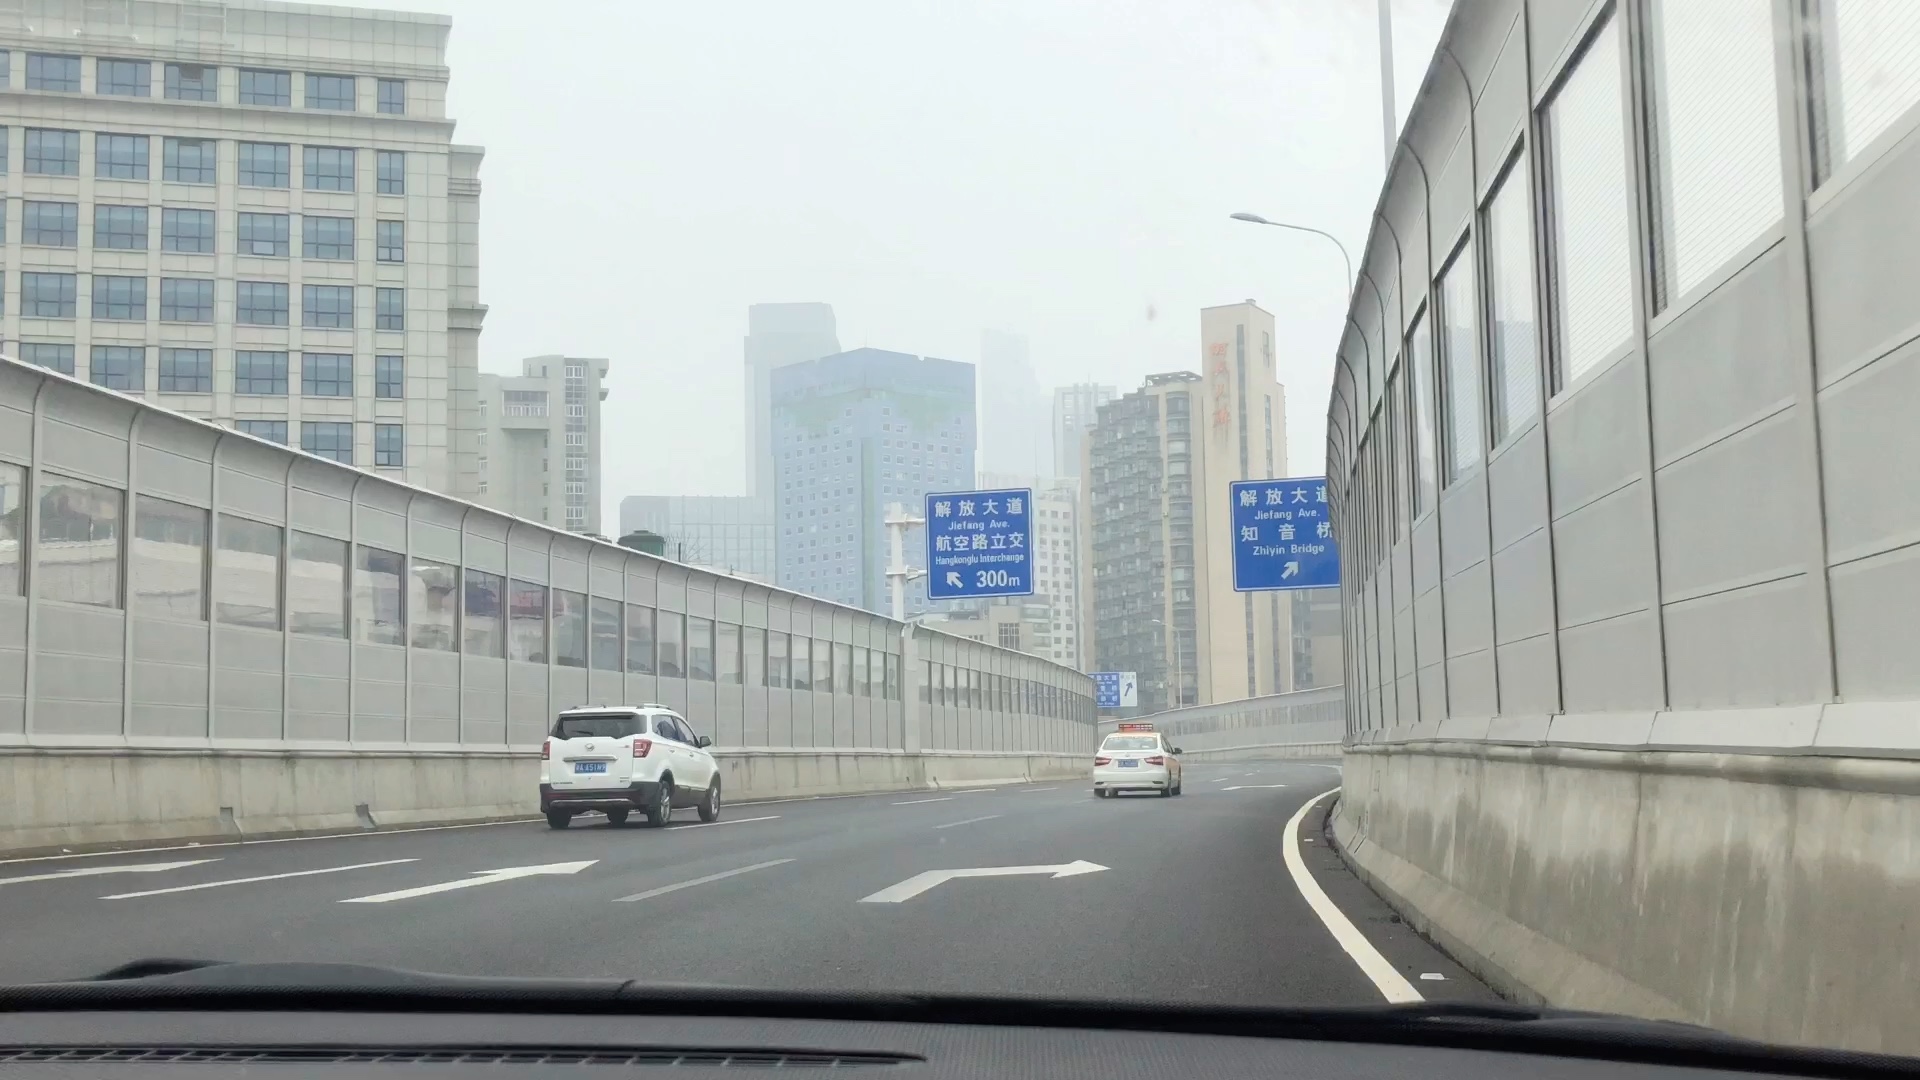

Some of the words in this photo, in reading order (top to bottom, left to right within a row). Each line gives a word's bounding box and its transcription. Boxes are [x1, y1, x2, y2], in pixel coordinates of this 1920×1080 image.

[934, 497, 1023, 518] 解放大道
[1254, 510, 1292, 521] Jiefang
[1298, 508, 1321, 518] Ave.
[948, 520, 985, 531] Jiefang
[989, 519, 1010, 529] Ave.
[1241, 521, 1333, 542] 知音桥
[936, 531, 1024, 552] 航空路立交
[1252, 546, 1285, 557] Zhiyin
[1290, 543, 1325, 555] Bridge
[935, 554, 978, 566] Hangkonglu
[980, 553, 1025, 564] Interchange
[976, 570, 1020, 588] 300m
